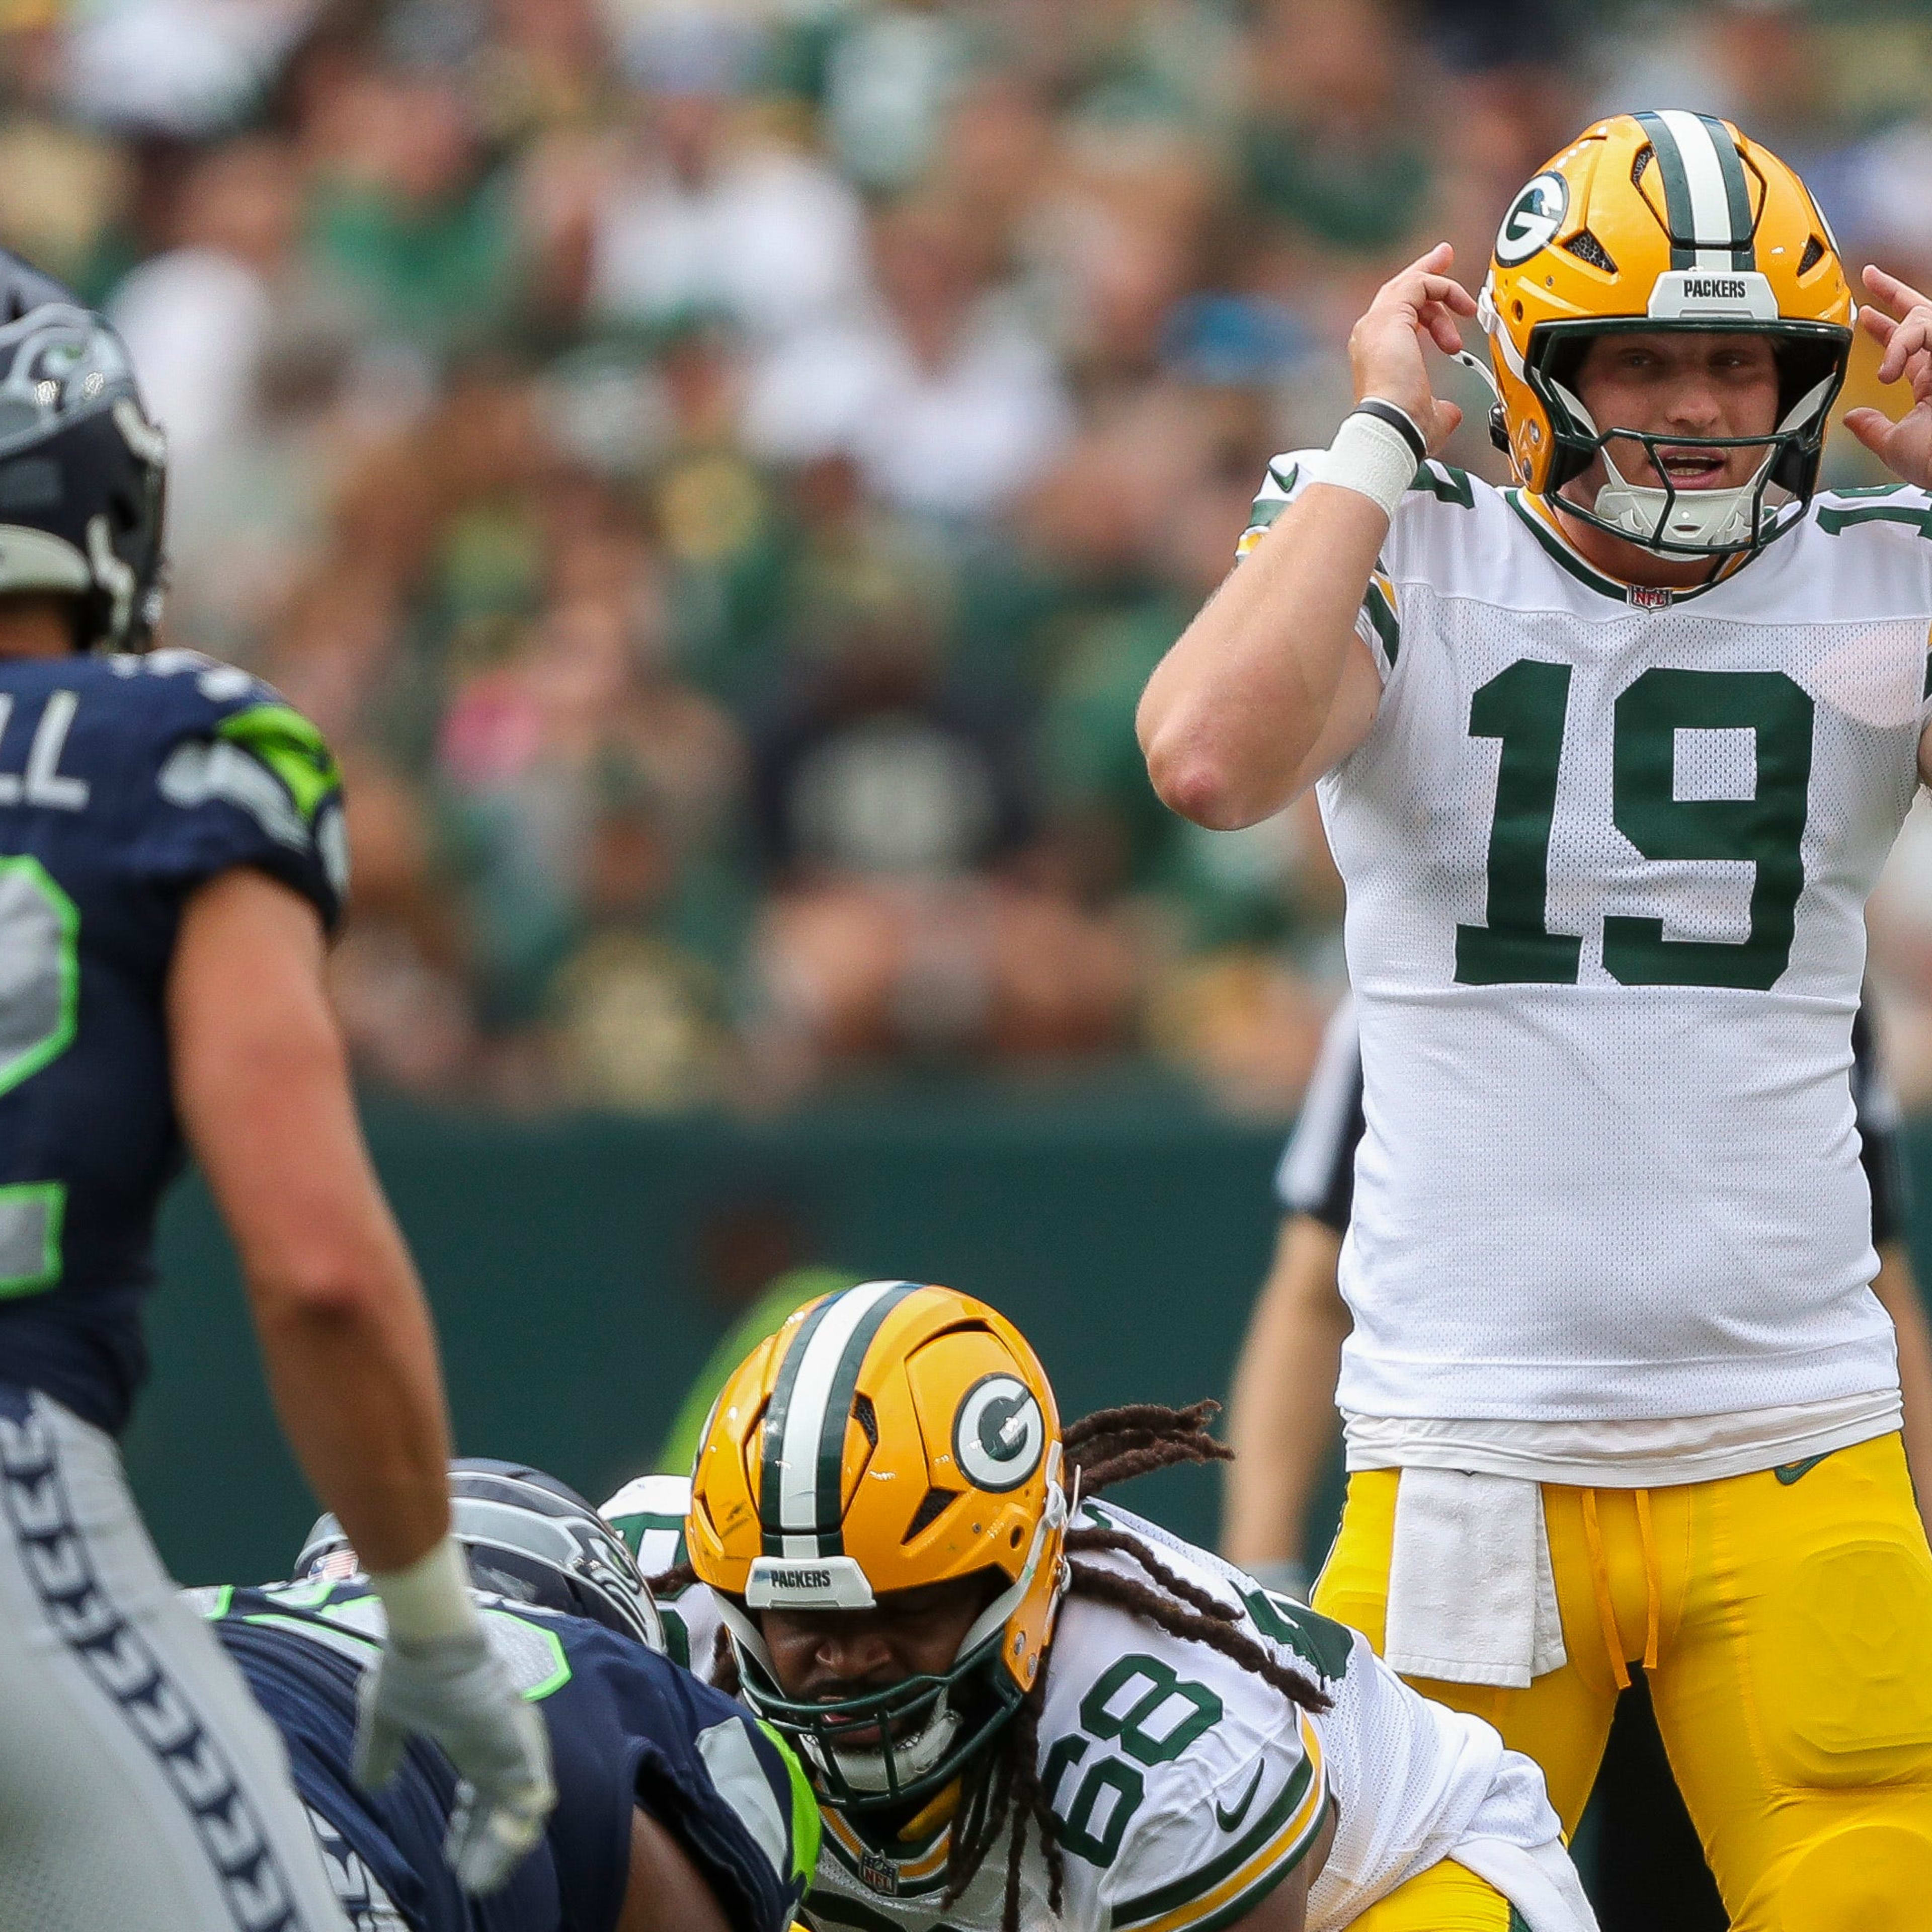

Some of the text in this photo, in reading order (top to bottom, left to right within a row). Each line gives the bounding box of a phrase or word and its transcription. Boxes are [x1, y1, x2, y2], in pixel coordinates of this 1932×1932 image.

[1683, 279, 1746, 298] PACKERS
[1635, 592, 1665, 607] NFL
[1454, 658, 1815, 991] 19
[770, 1569, 831, 1588] PACKERS
[1041, 1653, 1223, 1869] 68
[863, 1867, 893, 1891] NFL
